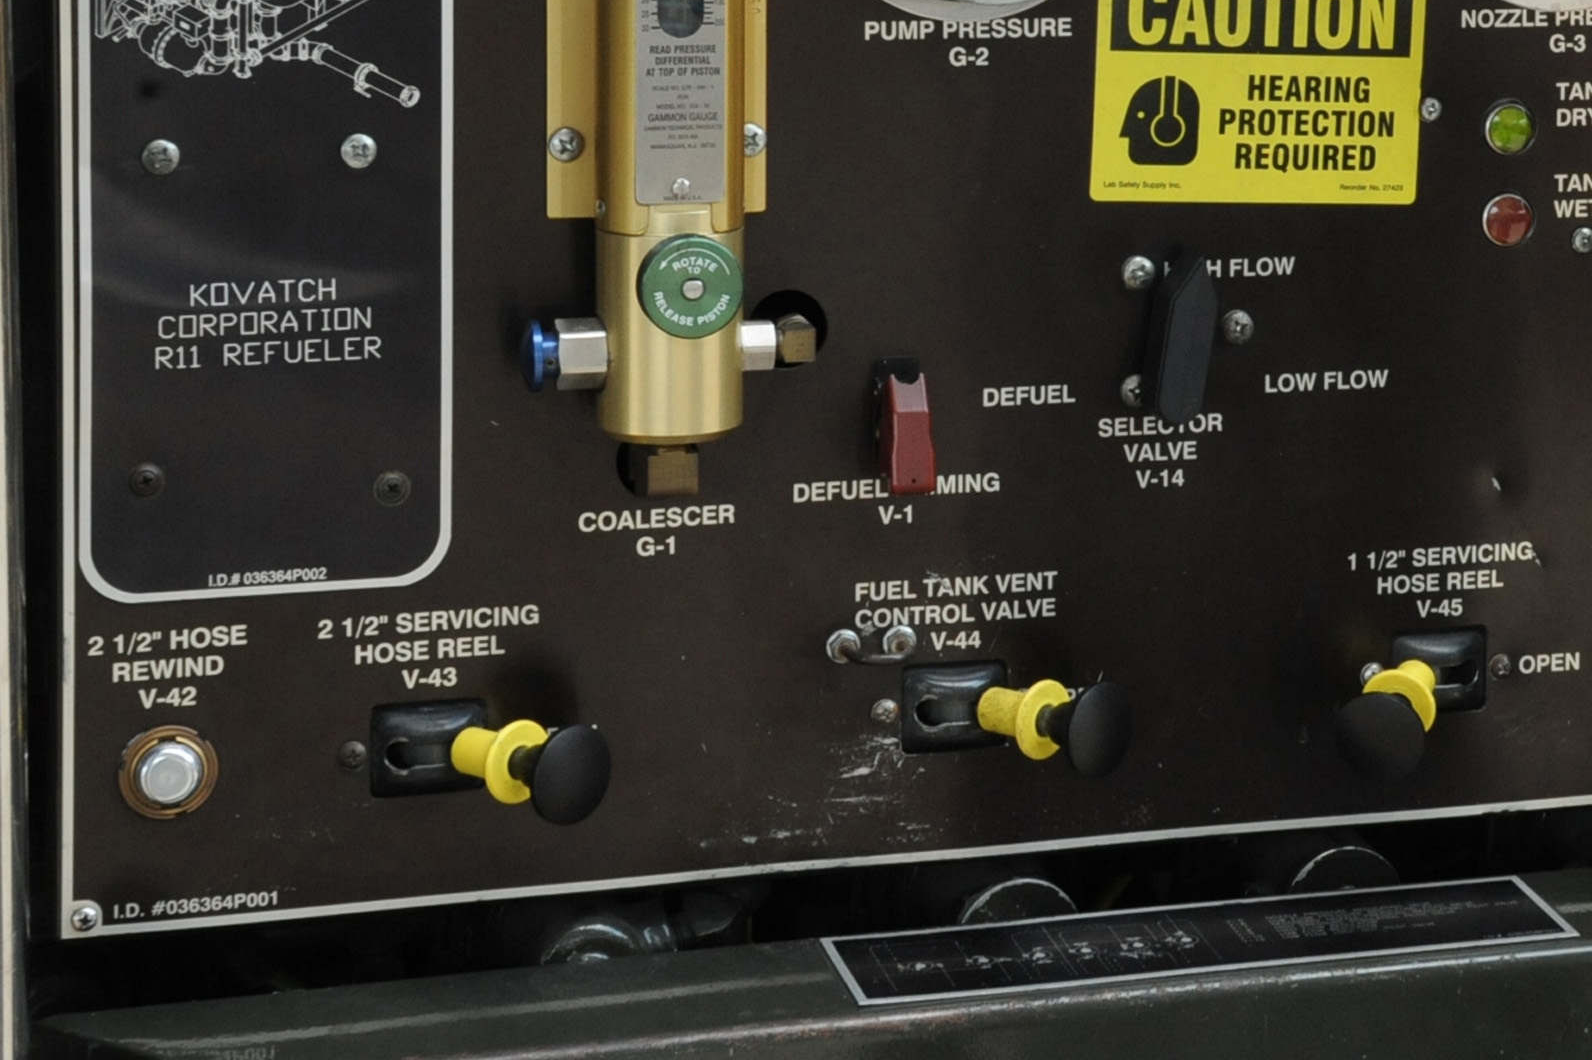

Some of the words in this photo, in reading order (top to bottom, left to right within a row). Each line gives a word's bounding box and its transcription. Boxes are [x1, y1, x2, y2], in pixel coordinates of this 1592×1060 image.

[865, 20, 934, 40] PUMP
[942, 18, 1072, 39] PRESSURE
[1461, 8, 1548, 29] NOZZLE
[650, 45, 671, 54] READ
[674, 45, 716, 53] PRESSURE
[1550, 34, 1586, 52] G-3
[655, 56, 710, 65] DIFFERENTIAL
[949, 47, 988, 66] G-2
[646, 68, 657, 77] AT
[659, 68, 674, 76] TOP
[677, 67, 688, 76] OF
[691, 67, 720, 76] PISTON
[1248, 75, 1369, 103] HEARING
[648, 113, 687, 122] GAMMON
[689, 112, 718, 121] GAUGE
[1219, 109, 1394, 137] PROTECTION
[1235, 143, 1375, 173] REQUIRED
[1103, 180, 1116, 189] Lab
[1118, 180, 1141, 190] Safety
[1143, 181, 1166, 189] Supply
[1169, 181, 1182, 189] Inc.
[1340, 183, 1367, 192] Reorder
[1369, 184, 1380, 192] No.
[672, 257, 718, 272] ROTATE
[687, 266, 701, 274] TO
[1230, 257, 1295, 277] FLOW
[190, 278, 336, 307] KOVATCH
[653, 291, 694, 327] RELEASE
[697, 294, 730, 326] PISTON
[157, 306, 373, 340] CORPORATION
[155, 346, 201, 369] R11
[224, 336, 381, 366] REFUELER
[1265, 373, 1316, 393] LOW
[1324, 369, 1388, 390] FLOW
[983, 385, 1075, 407] DEFUEL
[1098, 413, 1225, 439] SELECTOR
[1124, 441, 1197, 462] VALVE
[1136, 469, 1184, 488] V-14
[792, 478, 888, 504] DEFUEL
[579, 504, 734, 532] COALESCER
[879, 505, 912, 524] V-1
[636, 536, 675, 556] G-1
[1348, 553, 1356, 570] 1
[1367, 550, 1405, 570] 1/2"
[1412, 542, 1534, 567] SERVICING
[855, 580, 917, 602] FUEL
[923, 576, 988, 597] TANK
[995, 571, 1057, 593] VENT
[1378, 573, 1439, 594] HOSE
[1448, 570, 1504, 590] REEL
[854, 603, 975, 631] CONTROL
[981, 598, 1055, 620] VALVE
[1417, 598, 1463, 617] V-45
[318, 620, 333, 639] 2
[342, 616, 388, 638] 1/2"
[396, 605, 539, 633] SERVICING
[88, 636, 103, 656] 2
[113, 632, 161, 655] 1/2"
[170, 625, 247, 649] HOSE
[355, 640, 429, 664] HOSE
[438, 636, 505, 658] REEL
[931, 631, 981, 650] V-44
[113, 655, 224, 682] REWIND
[1519, 652, 1580, 674] OPEN
[402, 667, 457, 689] V-43
[139, 686, 196, 709] V-42
[112, 901, 145, 921] I.D.
[150, 889, 279, 917] #036364P001
